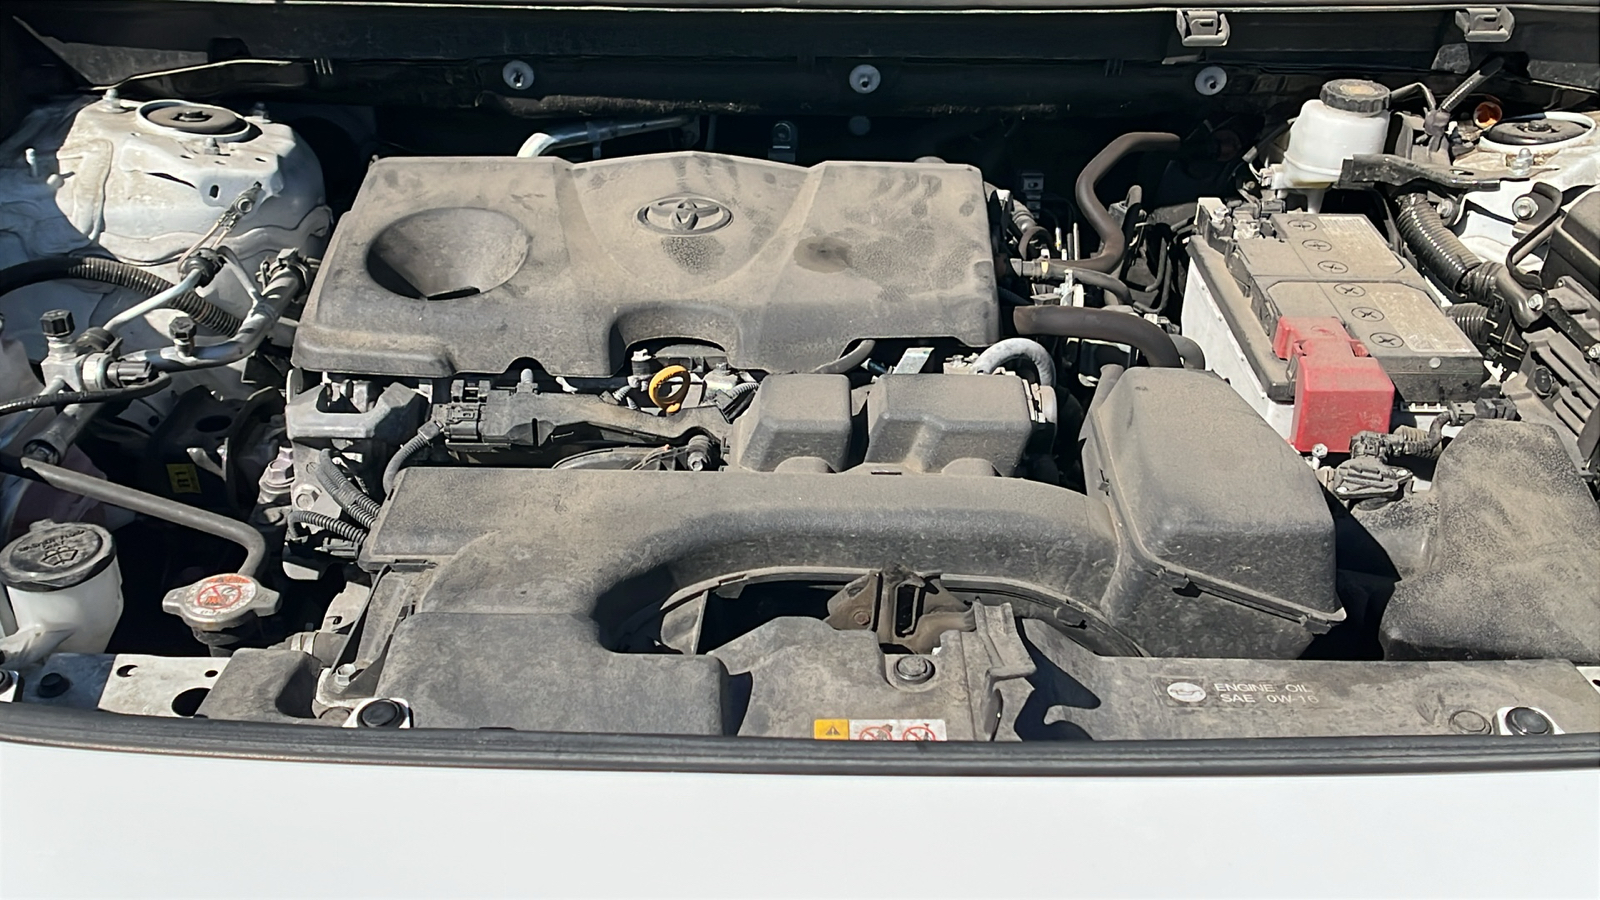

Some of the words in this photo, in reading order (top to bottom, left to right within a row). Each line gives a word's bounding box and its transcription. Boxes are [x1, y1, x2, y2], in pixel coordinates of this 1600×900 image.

[1213, 683, 1276, 693] ENGINE
[1285, 684, 1313, 693] OIL
[1220, 693, 1256, 703] SAE
[1266, 694, 1320, 704] 0W-16
